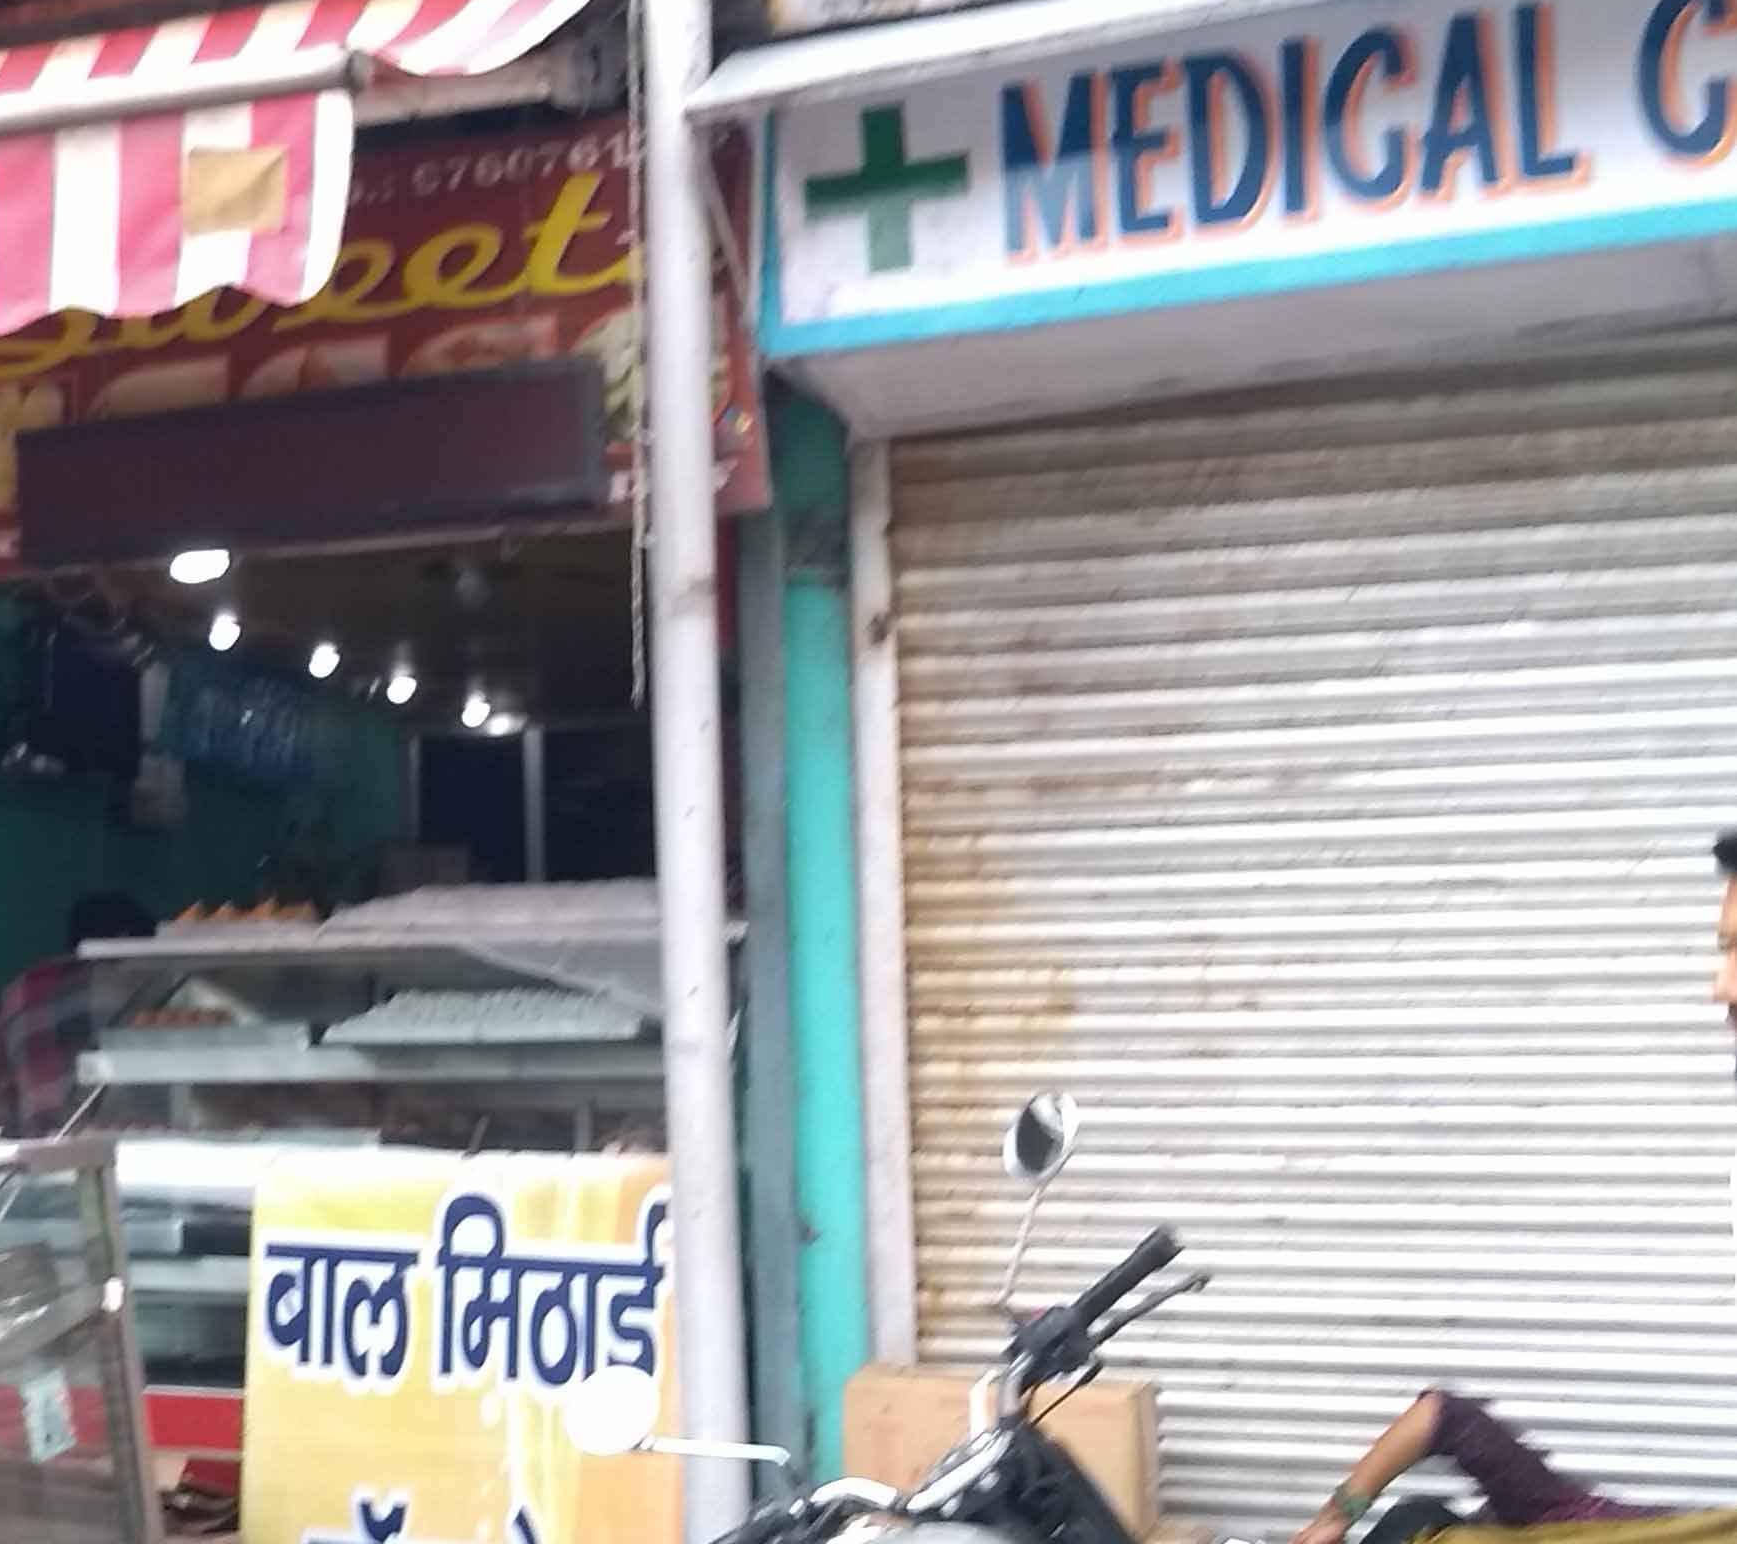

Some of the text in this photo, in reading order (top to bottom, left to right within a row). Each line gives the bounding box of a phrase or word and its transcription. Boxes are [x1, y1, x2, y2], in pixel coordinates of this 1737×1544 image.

[999, 0, 1593, 265] MEDICAL
[266, 1194, 671, 1386] बाल मिठाई
